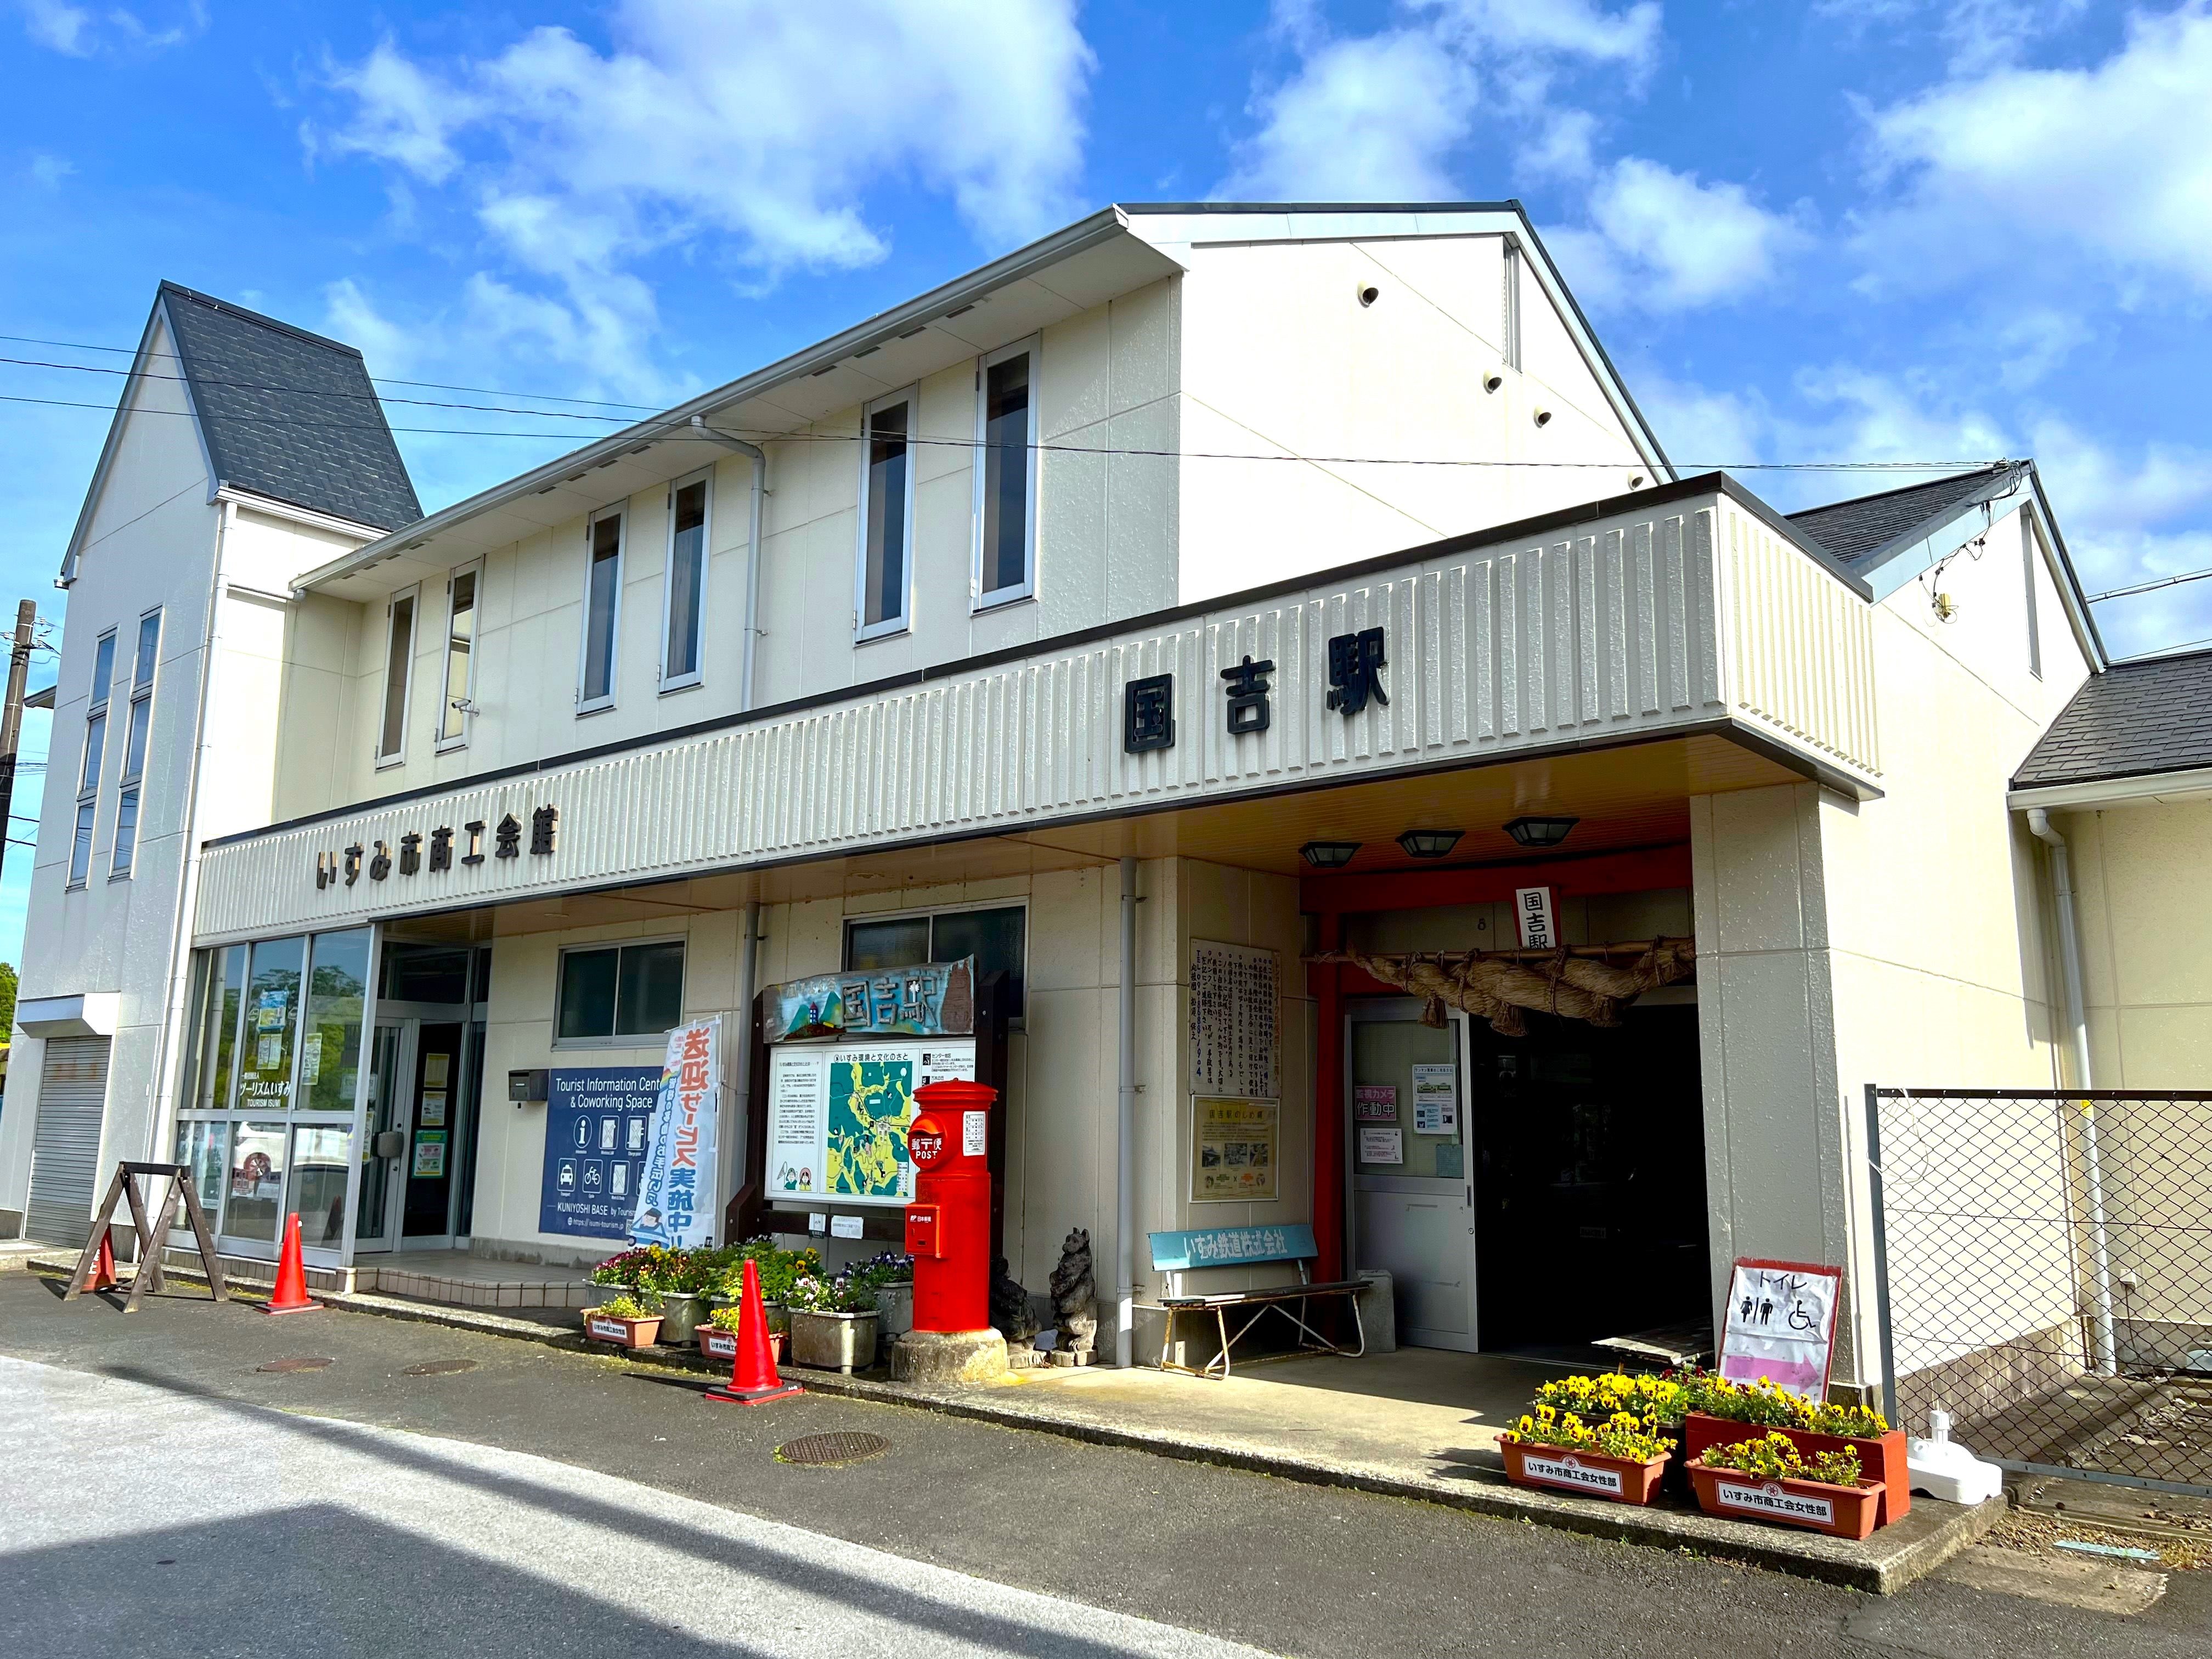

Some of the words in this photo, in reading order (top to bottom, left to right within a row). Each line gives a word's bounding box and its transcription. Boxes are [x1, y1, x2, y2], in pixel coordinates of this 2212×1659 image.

[1125, 626, 1390, 753] 国吉駅
[317, 804, 560, 889] いすみ市商工会館
[1523, 891, 1548, 950] 国吉駅
[841, 975, 938, 1028] 国吉駅
[240, 1081, 291, 1096] ツーリズムいすみ
[556, 1077, 584, 1092] Tourist
[587, 1078, 636, 1091] Information
[639, 1076, 660, 1091] Cent
[247, 1098, 267, 1107] TOURISM
[268, 1099, 281, 1107] ISUMI
[578, 1094, 623, 1111] Coworking
[625, 1097, 653, 1110] Space
[1357, 1102, 1395, 1116] 作動中
[916, 1150, 938, 1159] POST
[557, 1202, 590, 1214] KUNIYOSHI
[591, 1204, 608, 1216] BASE
[611, 1207, 617, 1217] by
[1183, 1229, 1288, 1260] いすみ鉄道株式会社
[1760, 1271, 1807, 1290] トイレ
[1528, 1462, 1617, 1487] いすみ市商工会女性部
[1723, 1489, 1827, 1516] いすみ市商工会女性部
